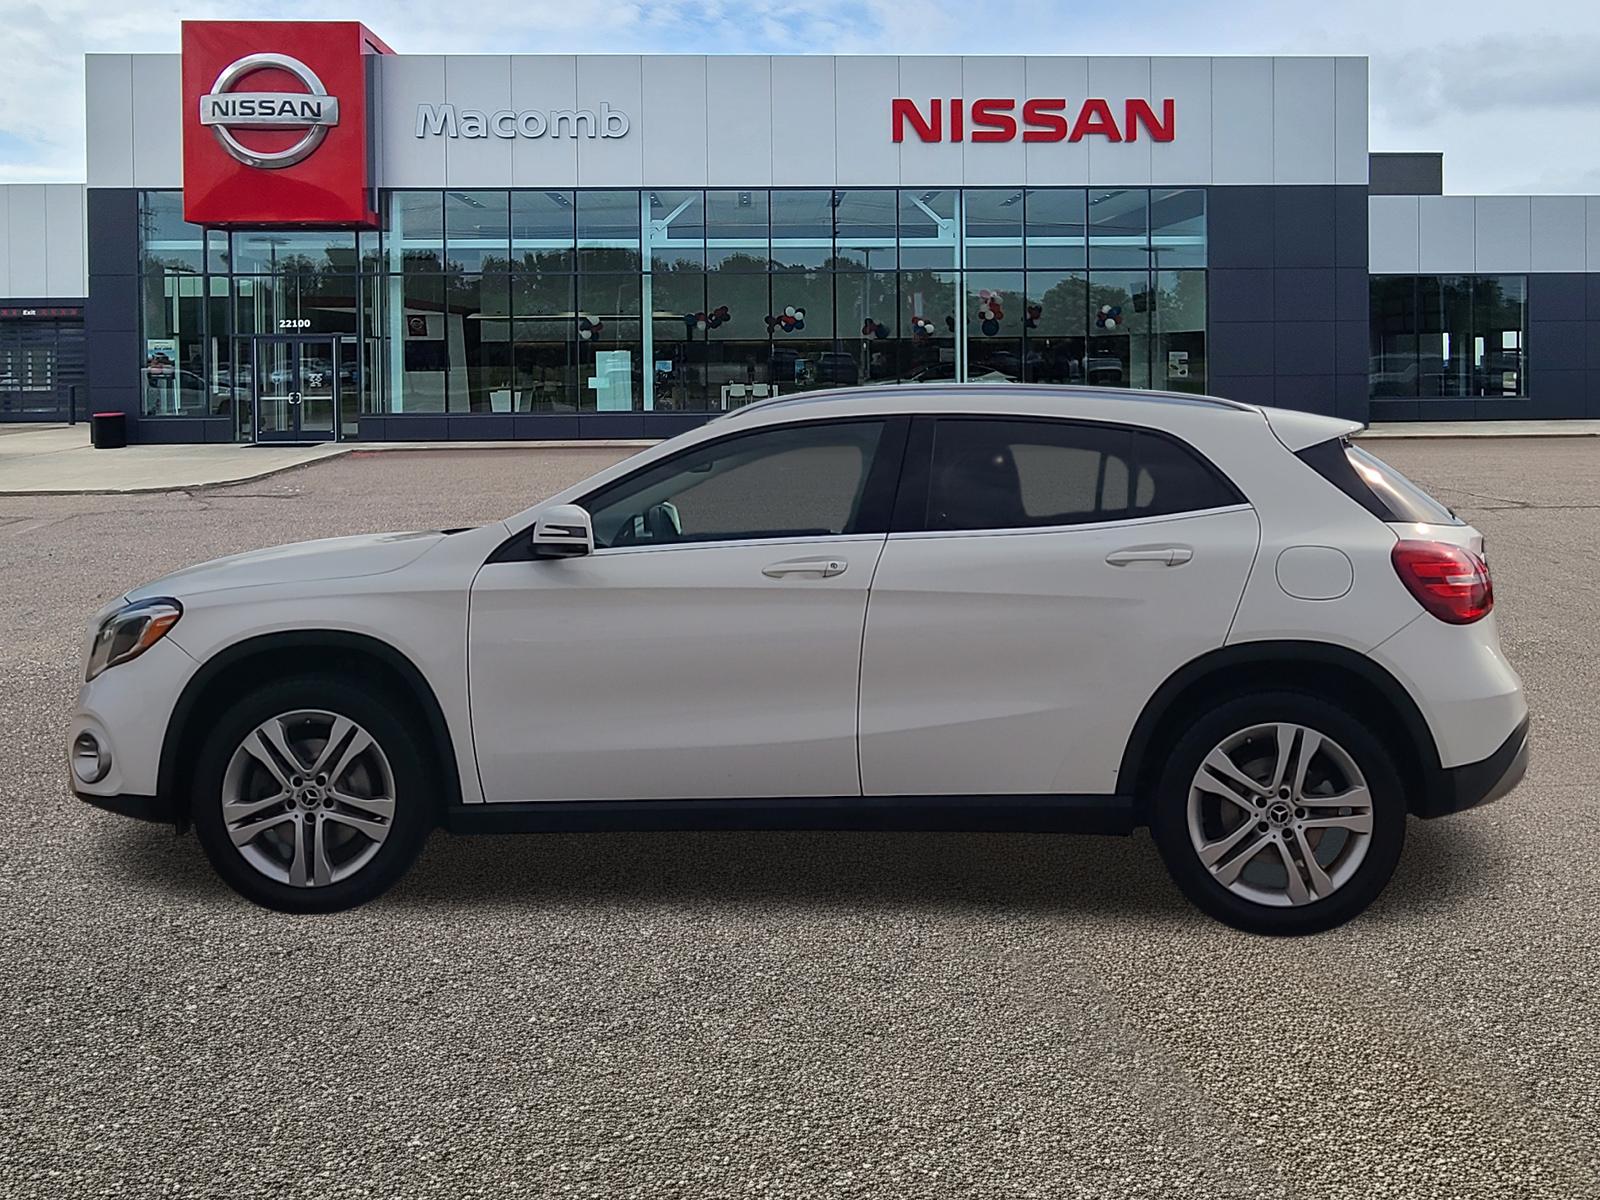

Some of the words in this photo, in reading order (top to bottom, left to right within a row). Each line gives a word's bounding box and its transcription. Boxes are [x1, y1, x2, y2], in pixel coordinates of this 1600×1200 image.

[212, 100, 322, 117] NISSAN
[415, 102, 630, 139] Macomb
[892, 98, 1175, 143] NISSAN
[279, 319, 311, 328] 22100
